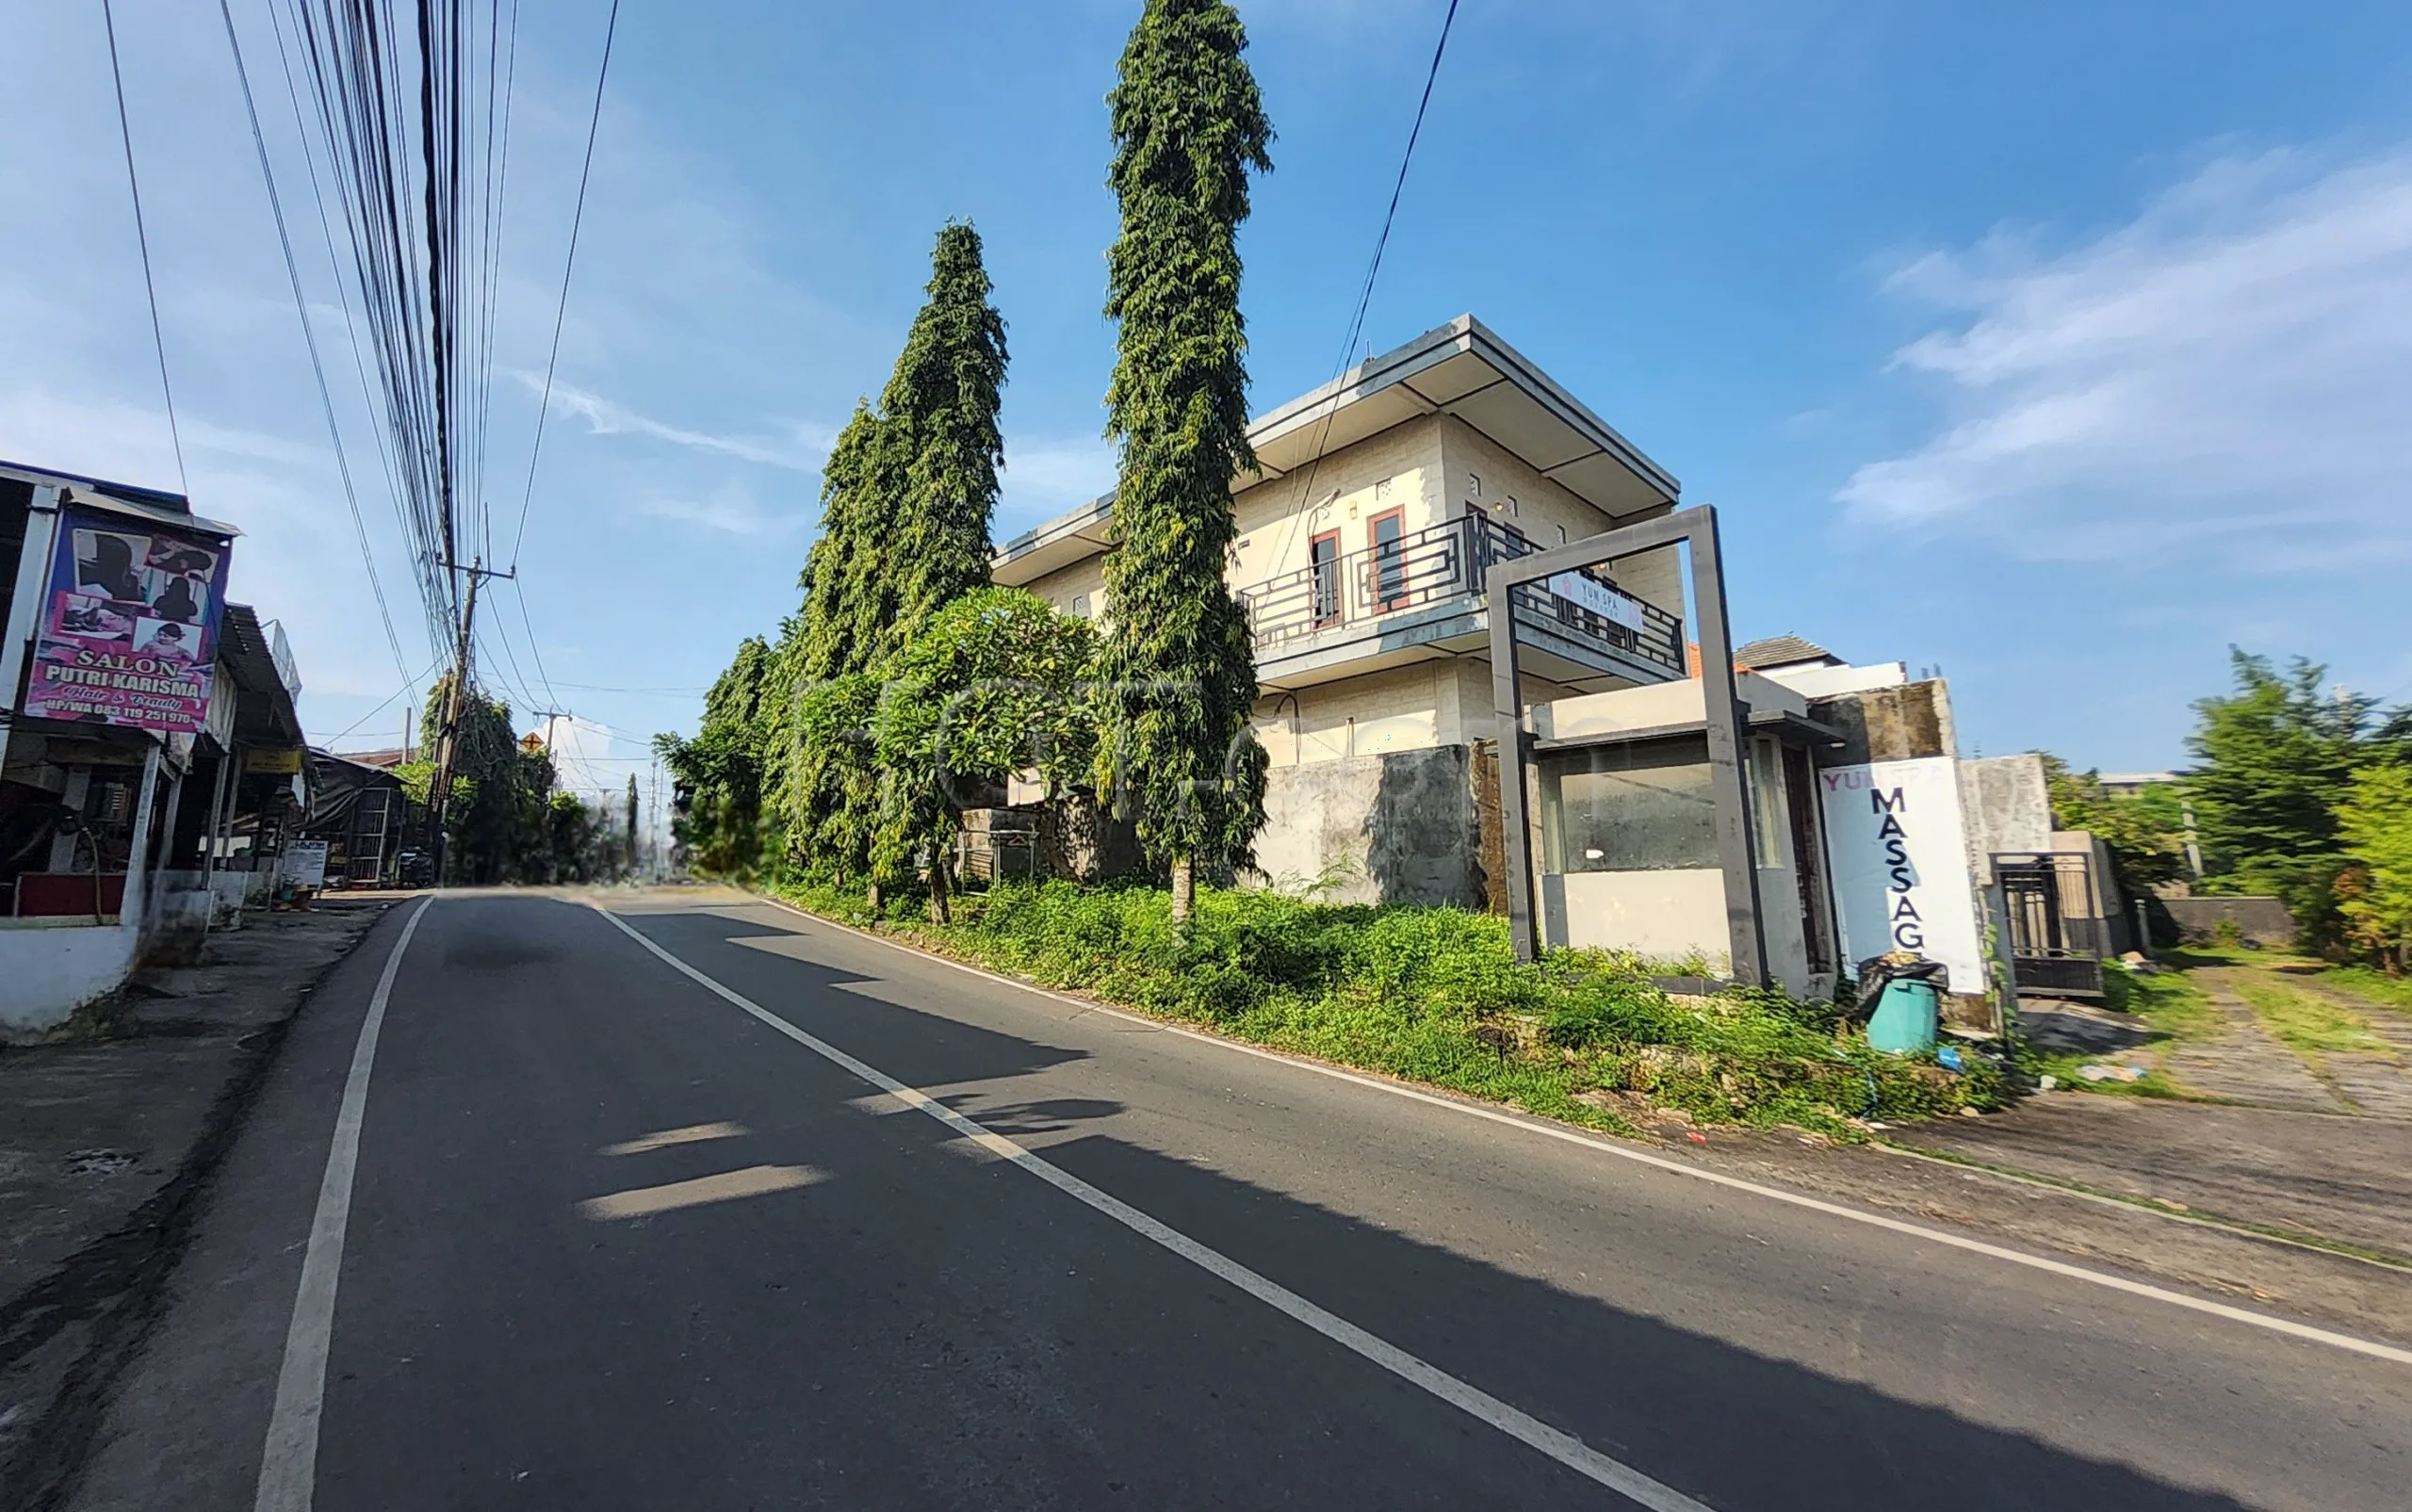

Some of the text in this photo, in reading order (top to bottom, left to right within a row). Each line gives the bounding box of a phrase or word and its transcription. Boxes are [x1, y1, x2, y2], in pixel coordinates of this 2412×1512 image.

[1581, 582, 1600, 601] YUN
[1602, 593, 1619, 610] SPA
[76, 650, 180, 676] SALON
[46, 665, 201, 698] PUTRI KARISMA
[145, 709, 166, 722] 251
[1870, 786, 1925, 956] MASSAG
